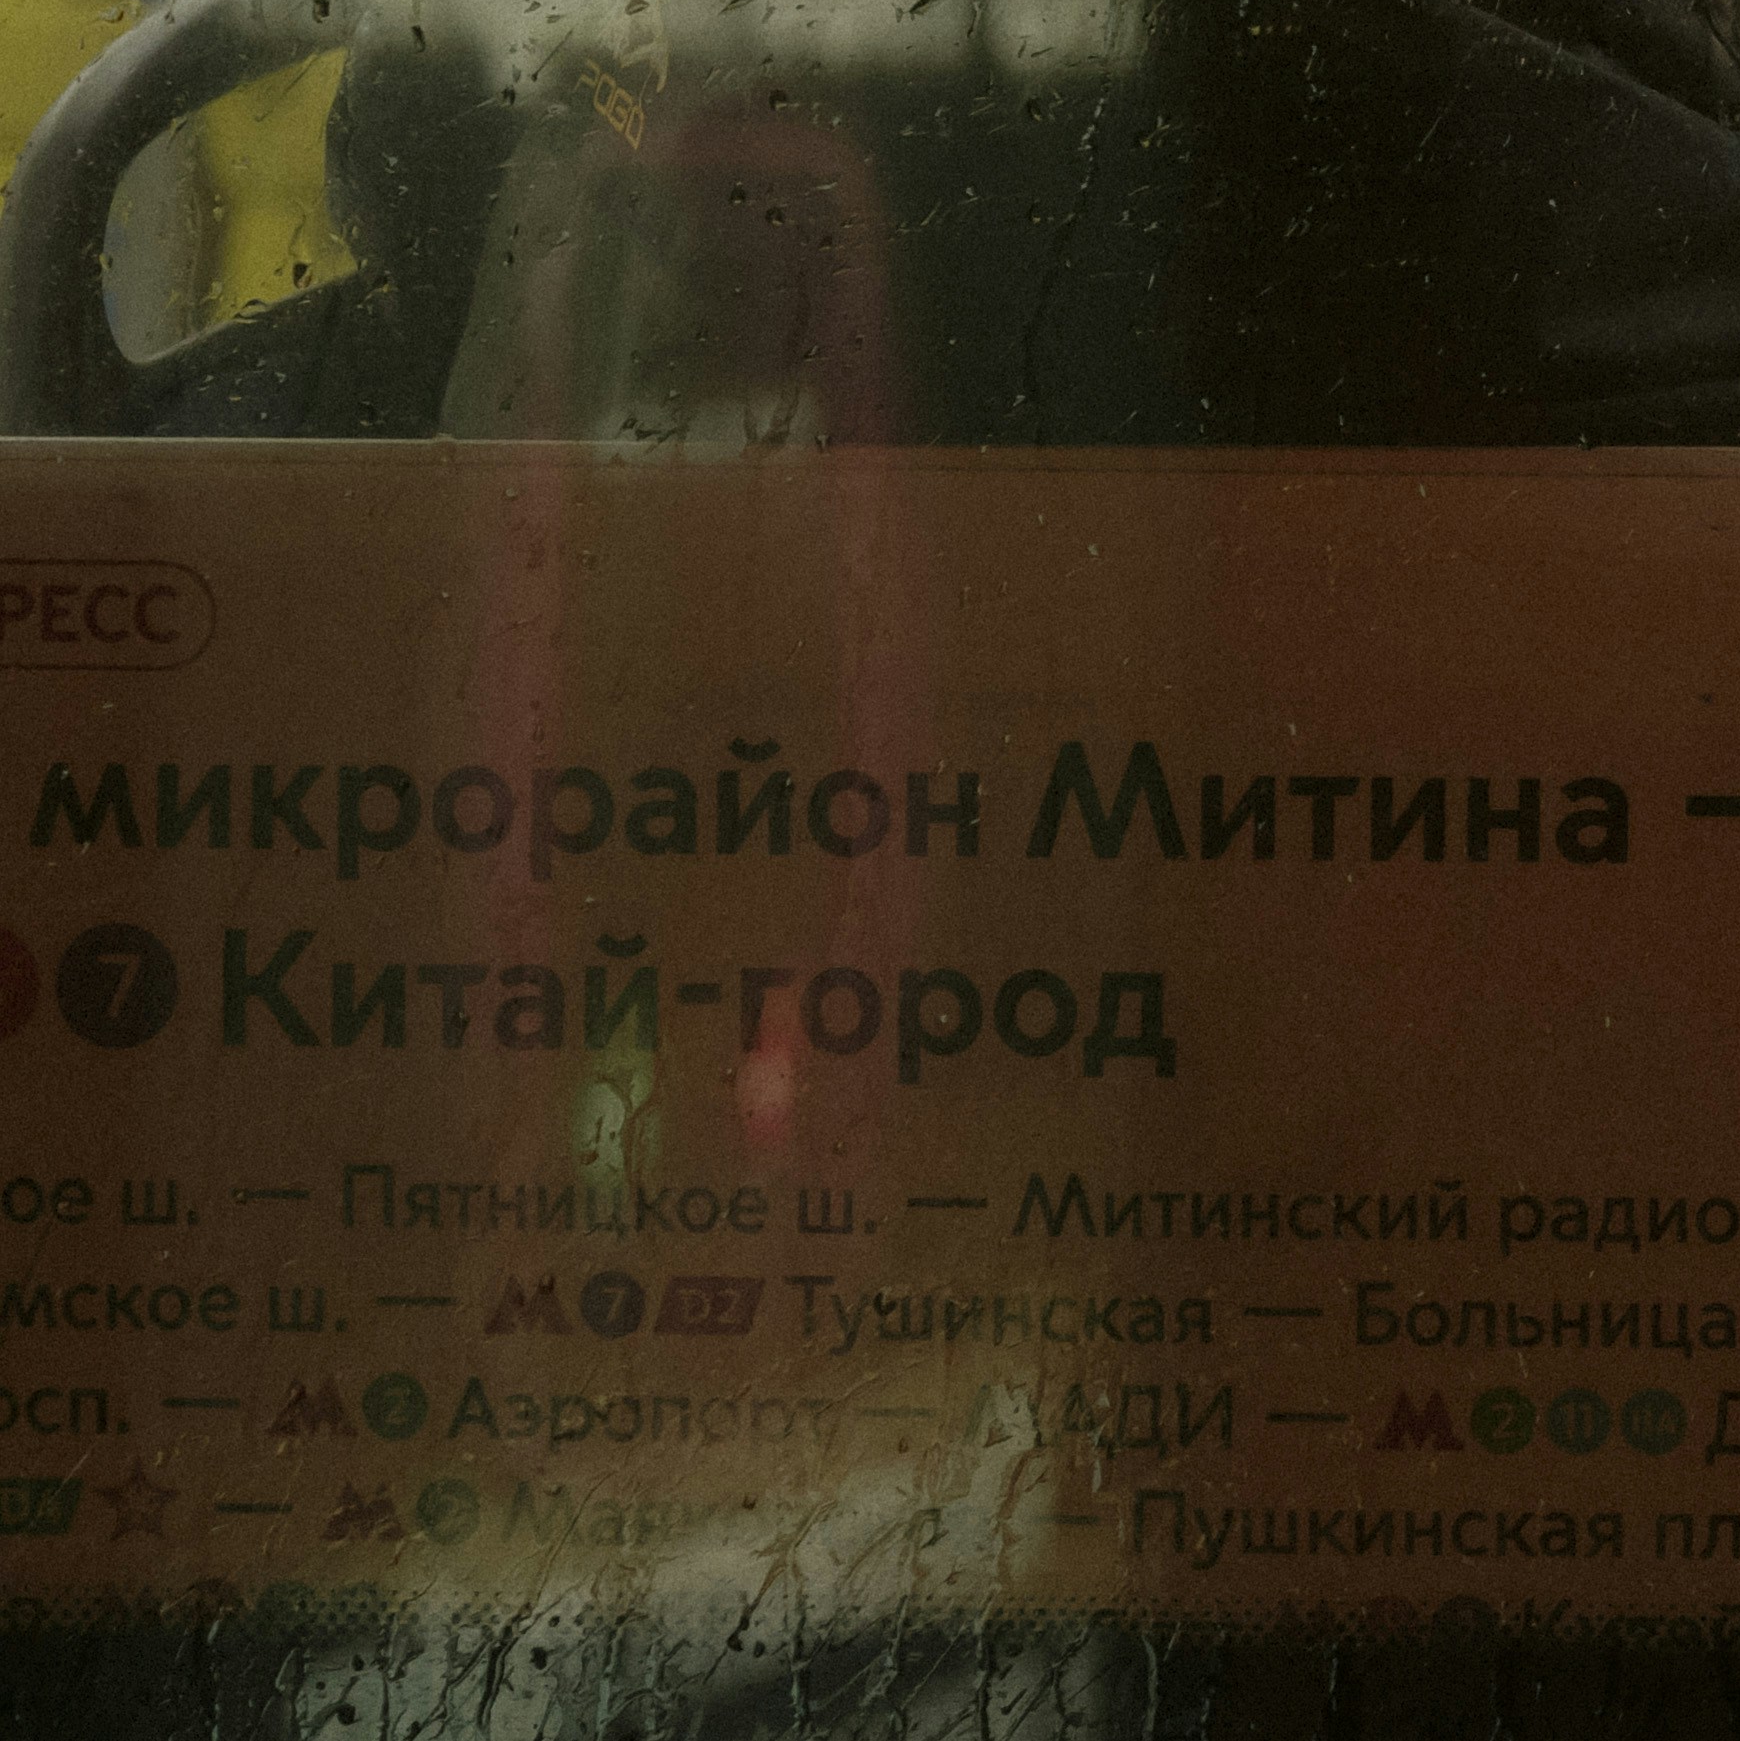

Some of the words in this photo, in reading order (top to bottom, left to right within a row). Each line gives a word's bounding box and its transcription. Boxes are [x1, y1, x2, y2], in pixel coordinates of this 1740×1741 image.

[28, 735, 981, 881] микрорайон
[1025, 739, 1631, 862] Митина
[222, 927, 1177, 1084] Китай-город
[121, 1178, 199, 1226] ш.
[341, 1163, 768, 1236] Пятницкое
[798, 1187, 879, 1235] ш.
[1012, 1172, 1469, 1242] Митинский
[268, 1286, 348, 1333] ш.
[782, 1274, 1214, 1356] Тушинская
[1355, 1281, 1738, 1360] Больница
[448, 1376, 834, 1453] Аэропорт
[1133, 1488, 1625, 1569] Пушкинская
